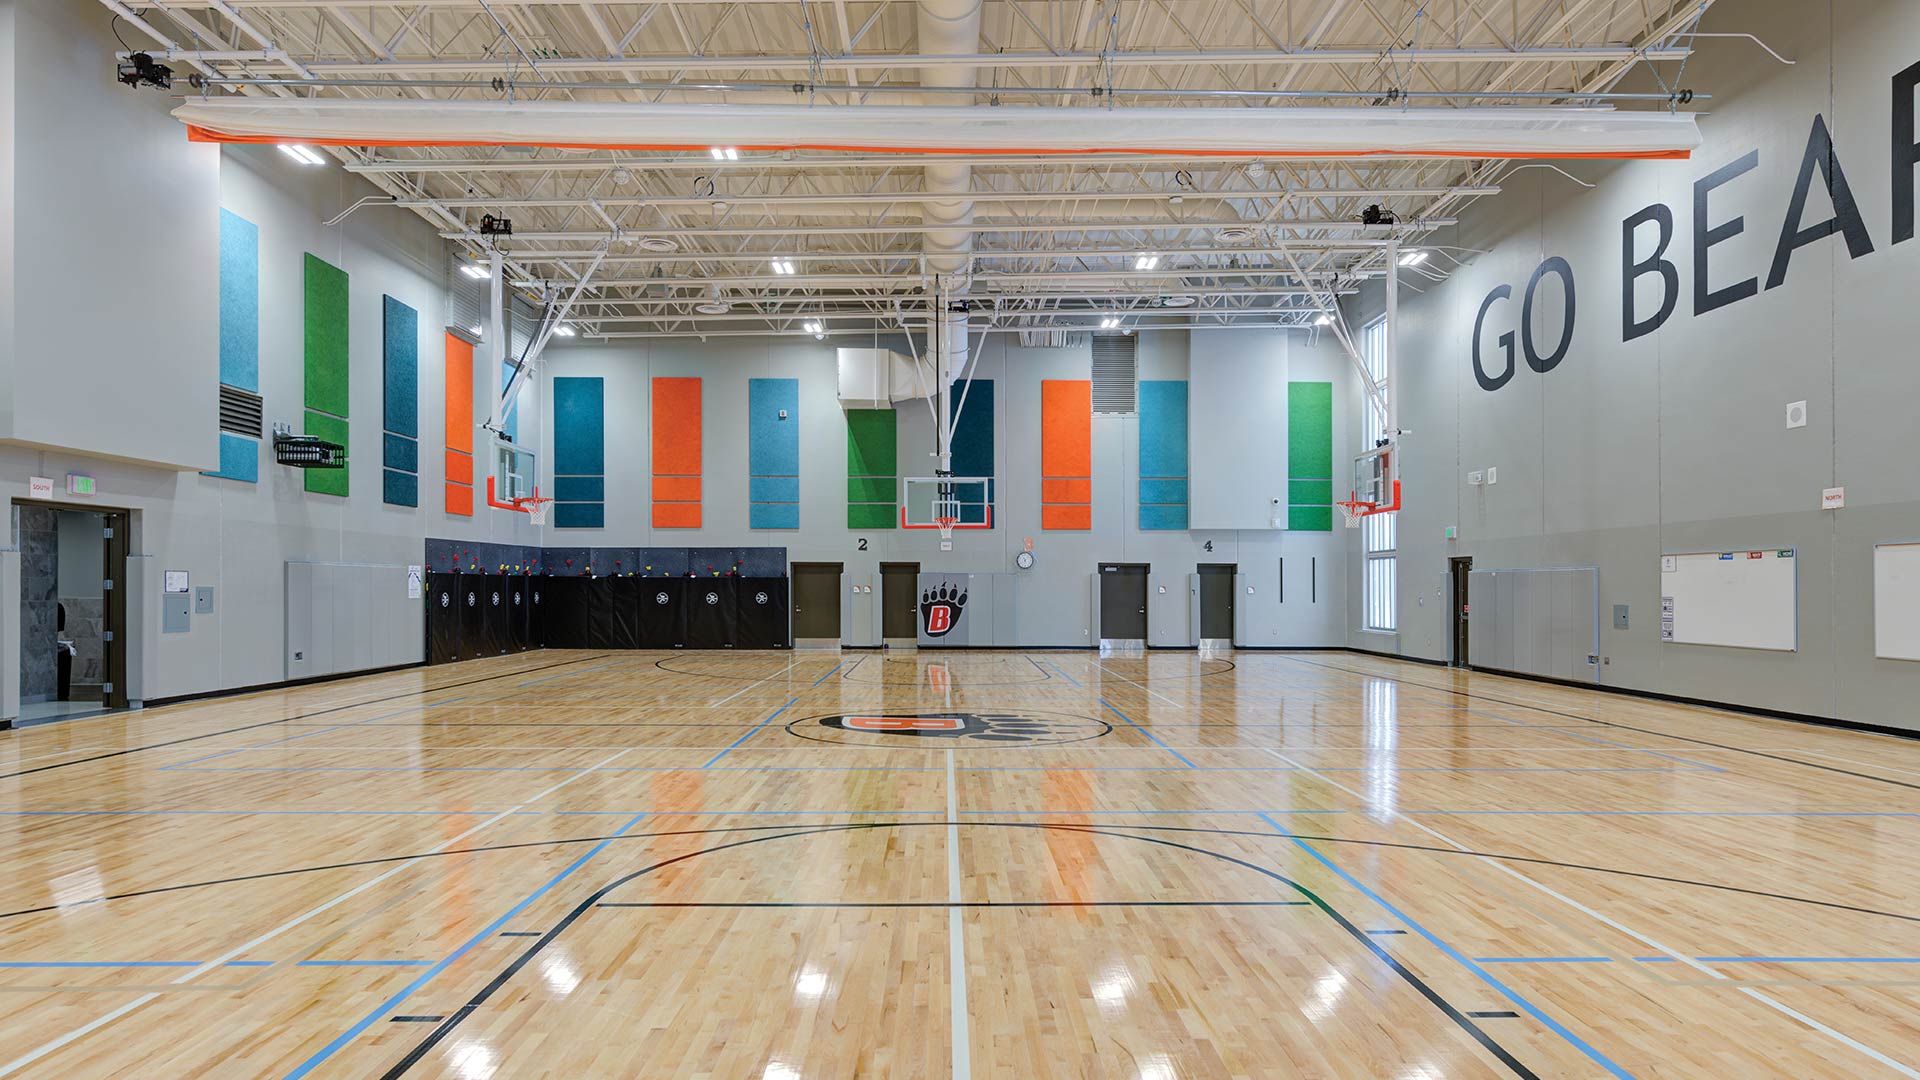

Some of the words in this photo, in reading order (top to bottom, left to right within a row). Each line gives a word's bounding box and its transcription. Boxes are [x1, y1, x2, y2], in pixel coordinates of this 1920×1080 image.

[1472, 256, 1576, 392] GO
[858, 538, 868, 550] 2
[1023, 537, 1033, 552] 3
[1203, 540, 1213, 552] 4
[928, 605, 951, 633] B
